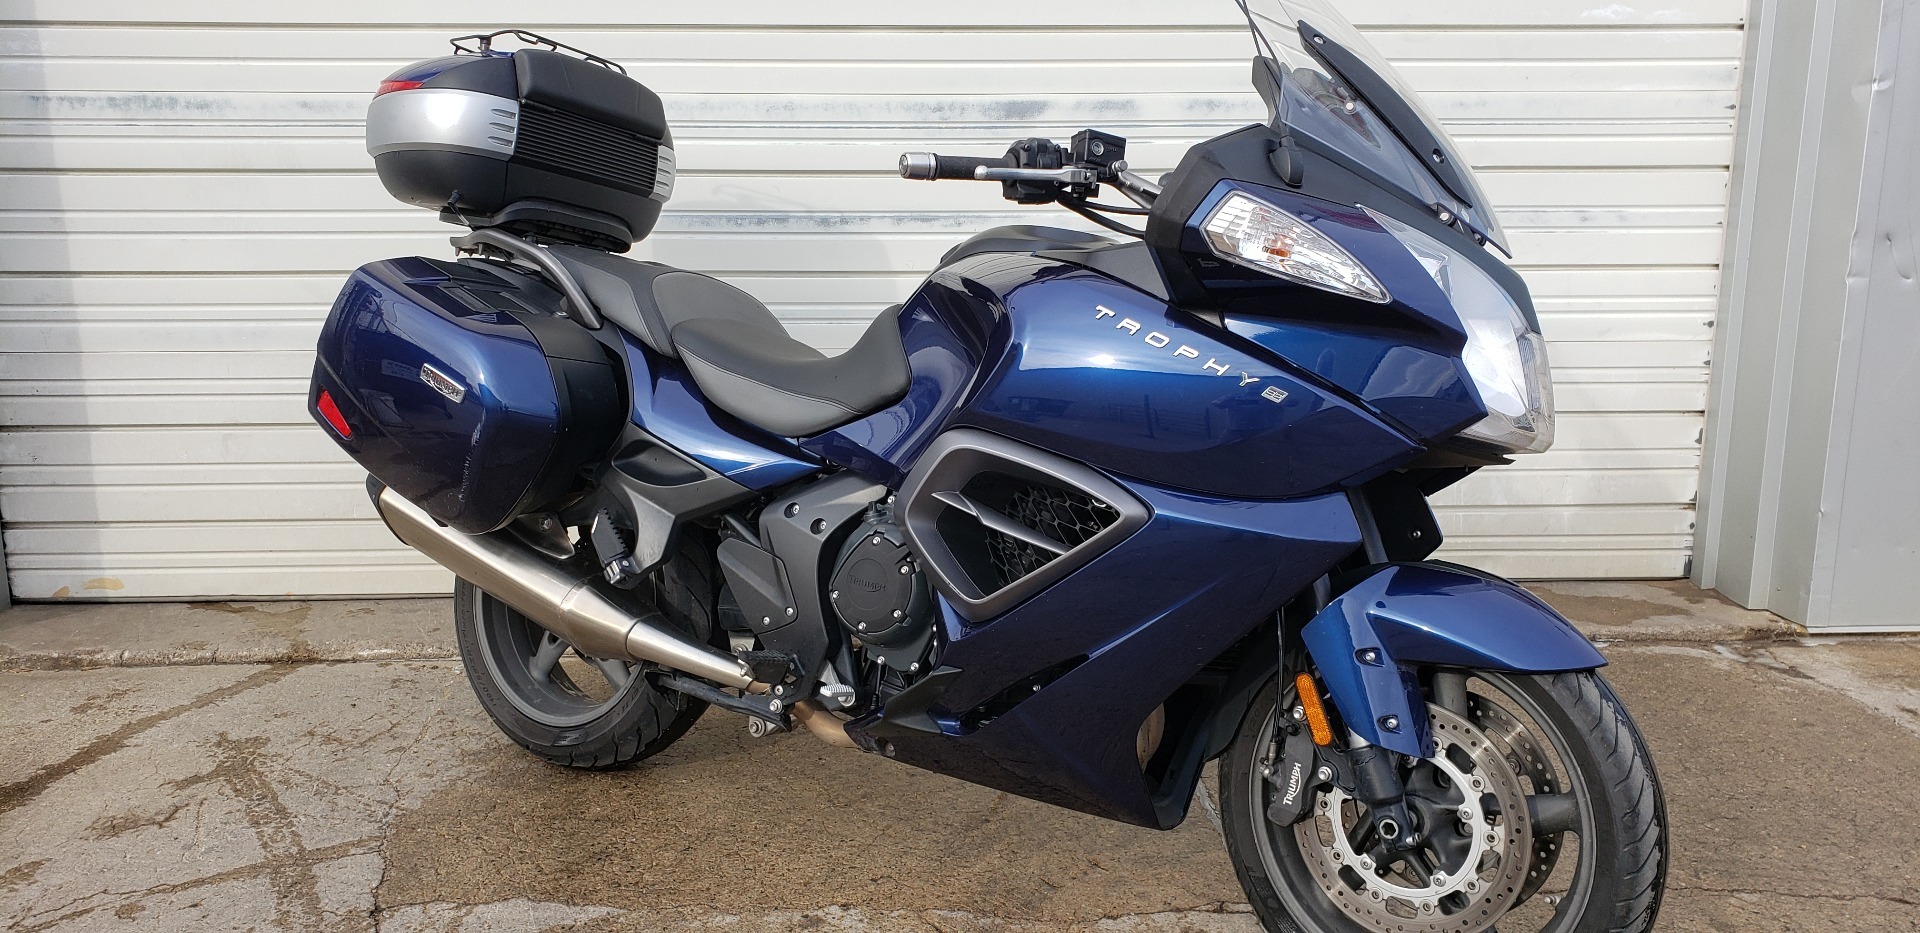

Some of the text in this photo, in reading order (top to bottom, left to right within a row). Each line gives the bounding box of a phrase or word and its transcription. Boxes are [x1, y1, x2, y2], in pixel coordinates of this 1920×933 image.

[1094, 304, 1287, 402] TROPHY SE
[848, 574, 887, 593] TRIUMPH
[1283, 762, 1302, 806] TRIUMPH
